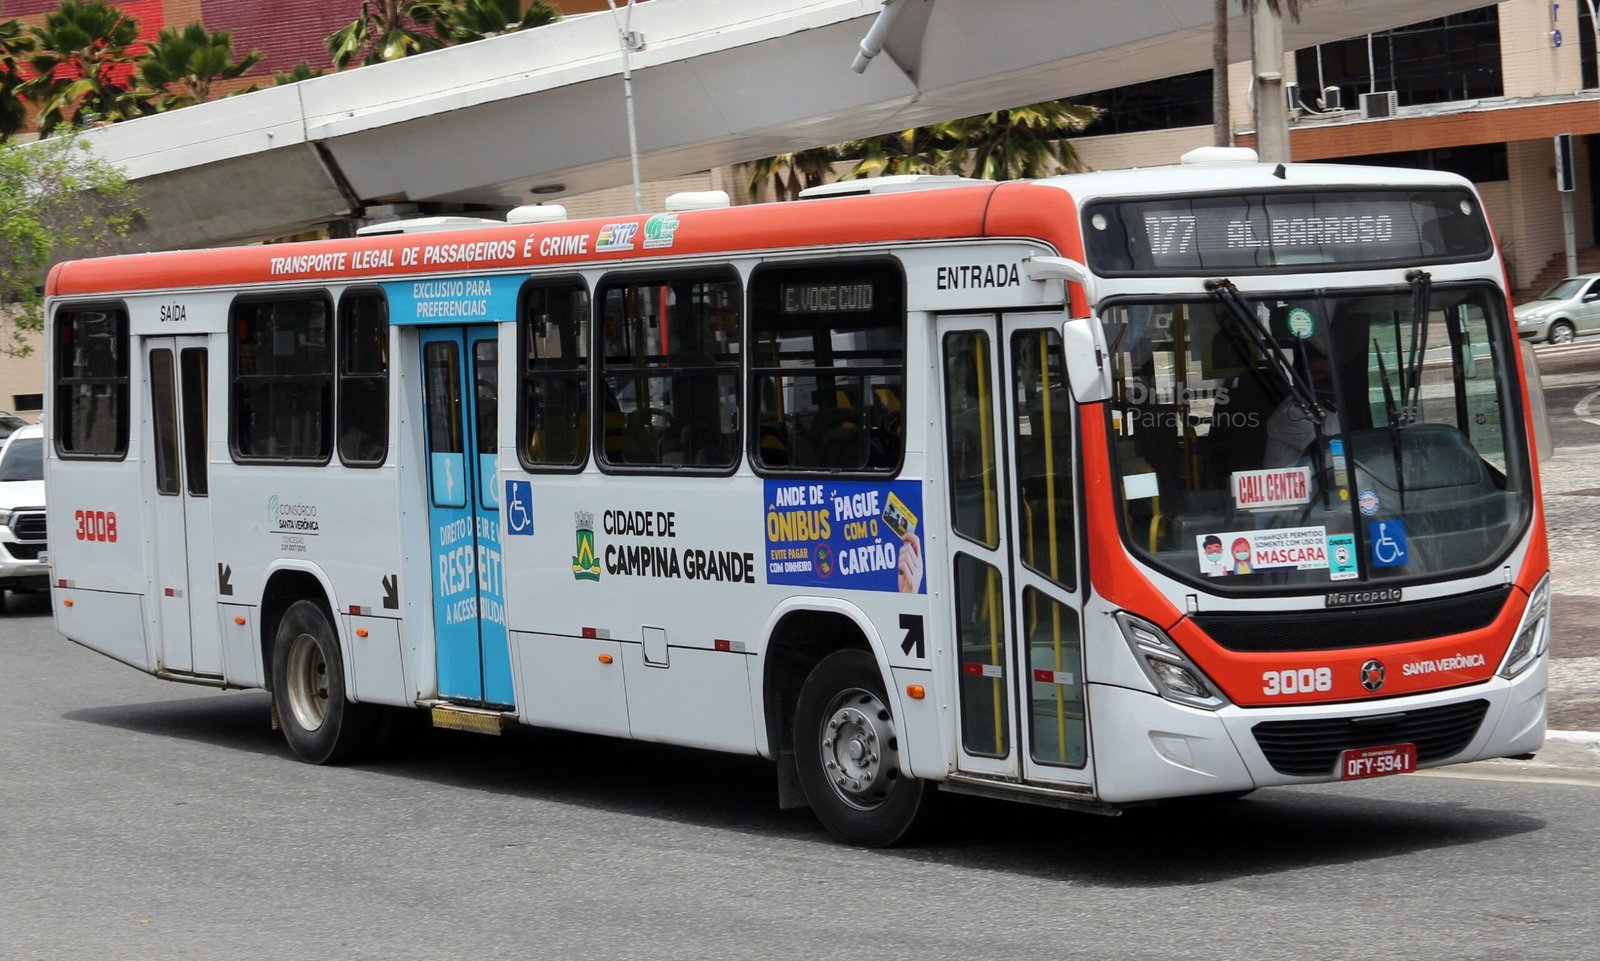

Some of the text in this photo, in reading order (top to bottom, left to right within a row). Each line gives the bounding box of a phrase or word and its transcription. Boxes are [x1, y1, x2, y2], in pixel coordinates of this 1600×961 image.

[1272, 215, 1392, 246] BARROSO
[271, 233, 590, 275] TRANSPORTE ILEGAL DE PASSAGEIROS É CRIME
[937, 263, 1020, 290] ENTRADA
[413, 280, 491, 299] EXCLUSIVO PARA
[160, 301, 187, 322] SAÍDA
[416, 300, 487, 318] PREFERENCIAIS
[776, 485, 824, 507] ANDE DE
[1238, 471, 1306, 504] CALL CENTER
[834, 491, 881, 522] PAGUE
[75, 510, 117, 543] 3008
[279, 519, 294, 529] SANTA
[440, 518, 466, 546] DIREITO
[603, 509, 676, 537] CIDADE DE
[767, 504, 832, 542] ÔNIBUS
[844, 519, 879, 541] COM O
[1289, 530, 1323, 539] PERMITIDO
[771, 548, 808, 560] EVITE PAGAR
[1254, 540, 1285, 549] SOMENTE
[1286, 539, 1300, 547] COM
[1302, 538, 1314, 546] USO
[605, 544, 755, 584] CAMPINA GRANDE
[770, 560, 812, 573] COM DINHEIRO
[838, 538, 897, 576] CARTÃO
[1256, 547, 1326, 565] MÁSCARA
[439, 544, 502, 597] RESPEIT
[1327, 588, 1401, 605] Marcopolo
[446, 604, 453, 625] A
[1403, 653, 1486, 677] SANTA VERÔNICA
[1262, 667, 1332, 696] 3008
